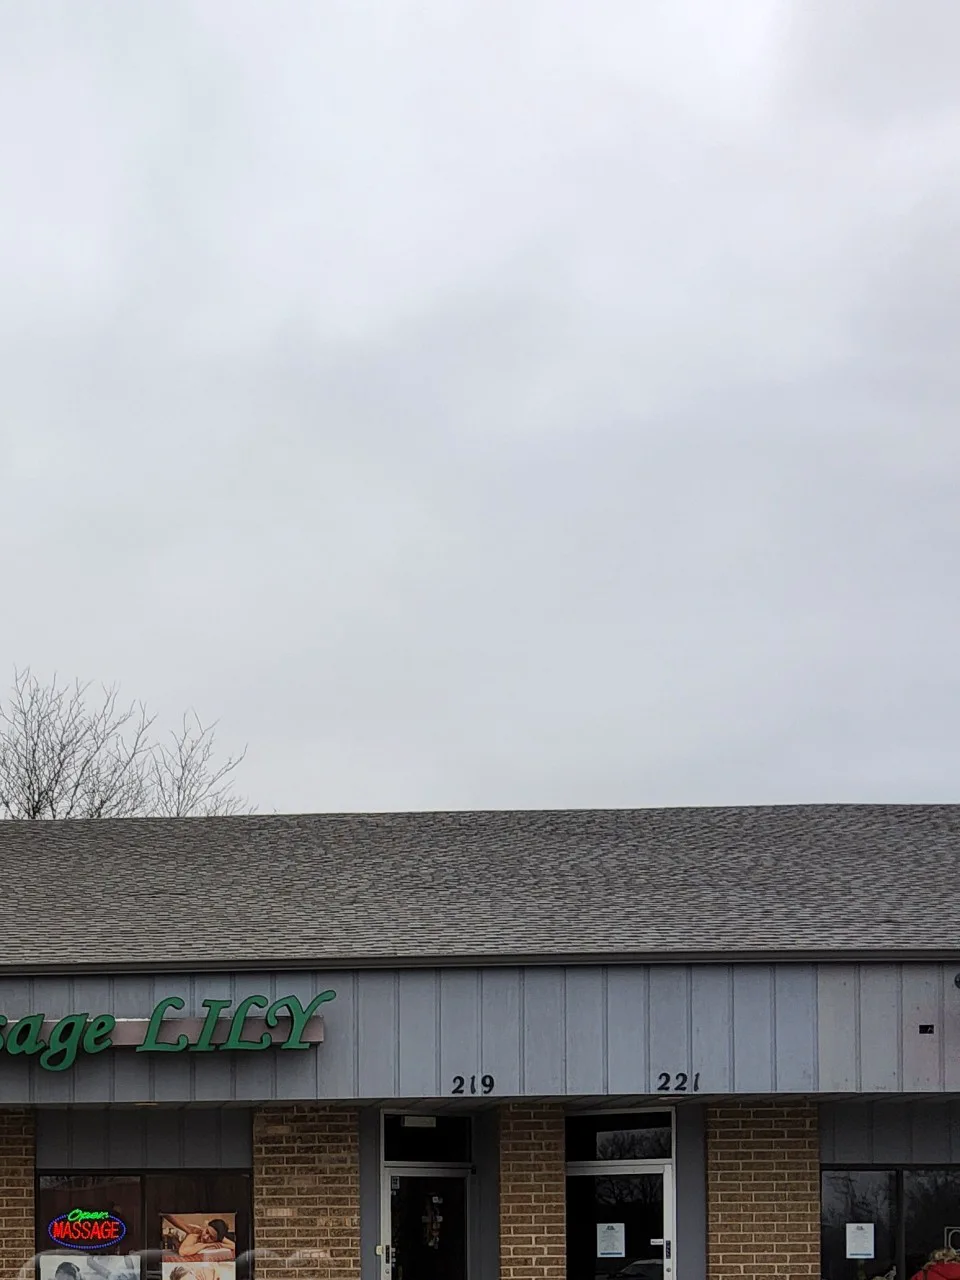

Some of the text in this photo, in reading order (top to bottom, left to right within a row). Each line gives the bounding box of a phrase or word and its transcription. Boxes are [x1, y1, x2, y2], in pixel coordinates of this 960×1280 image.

[135, 989, 337, 1054] LILY
[451, 1074, 496, 1096] 219
[657, 1071, 702, 1093] 221
[68, 1209, 109, 1221] Open
[53, 1221, 120, 1239] MASSAGE
